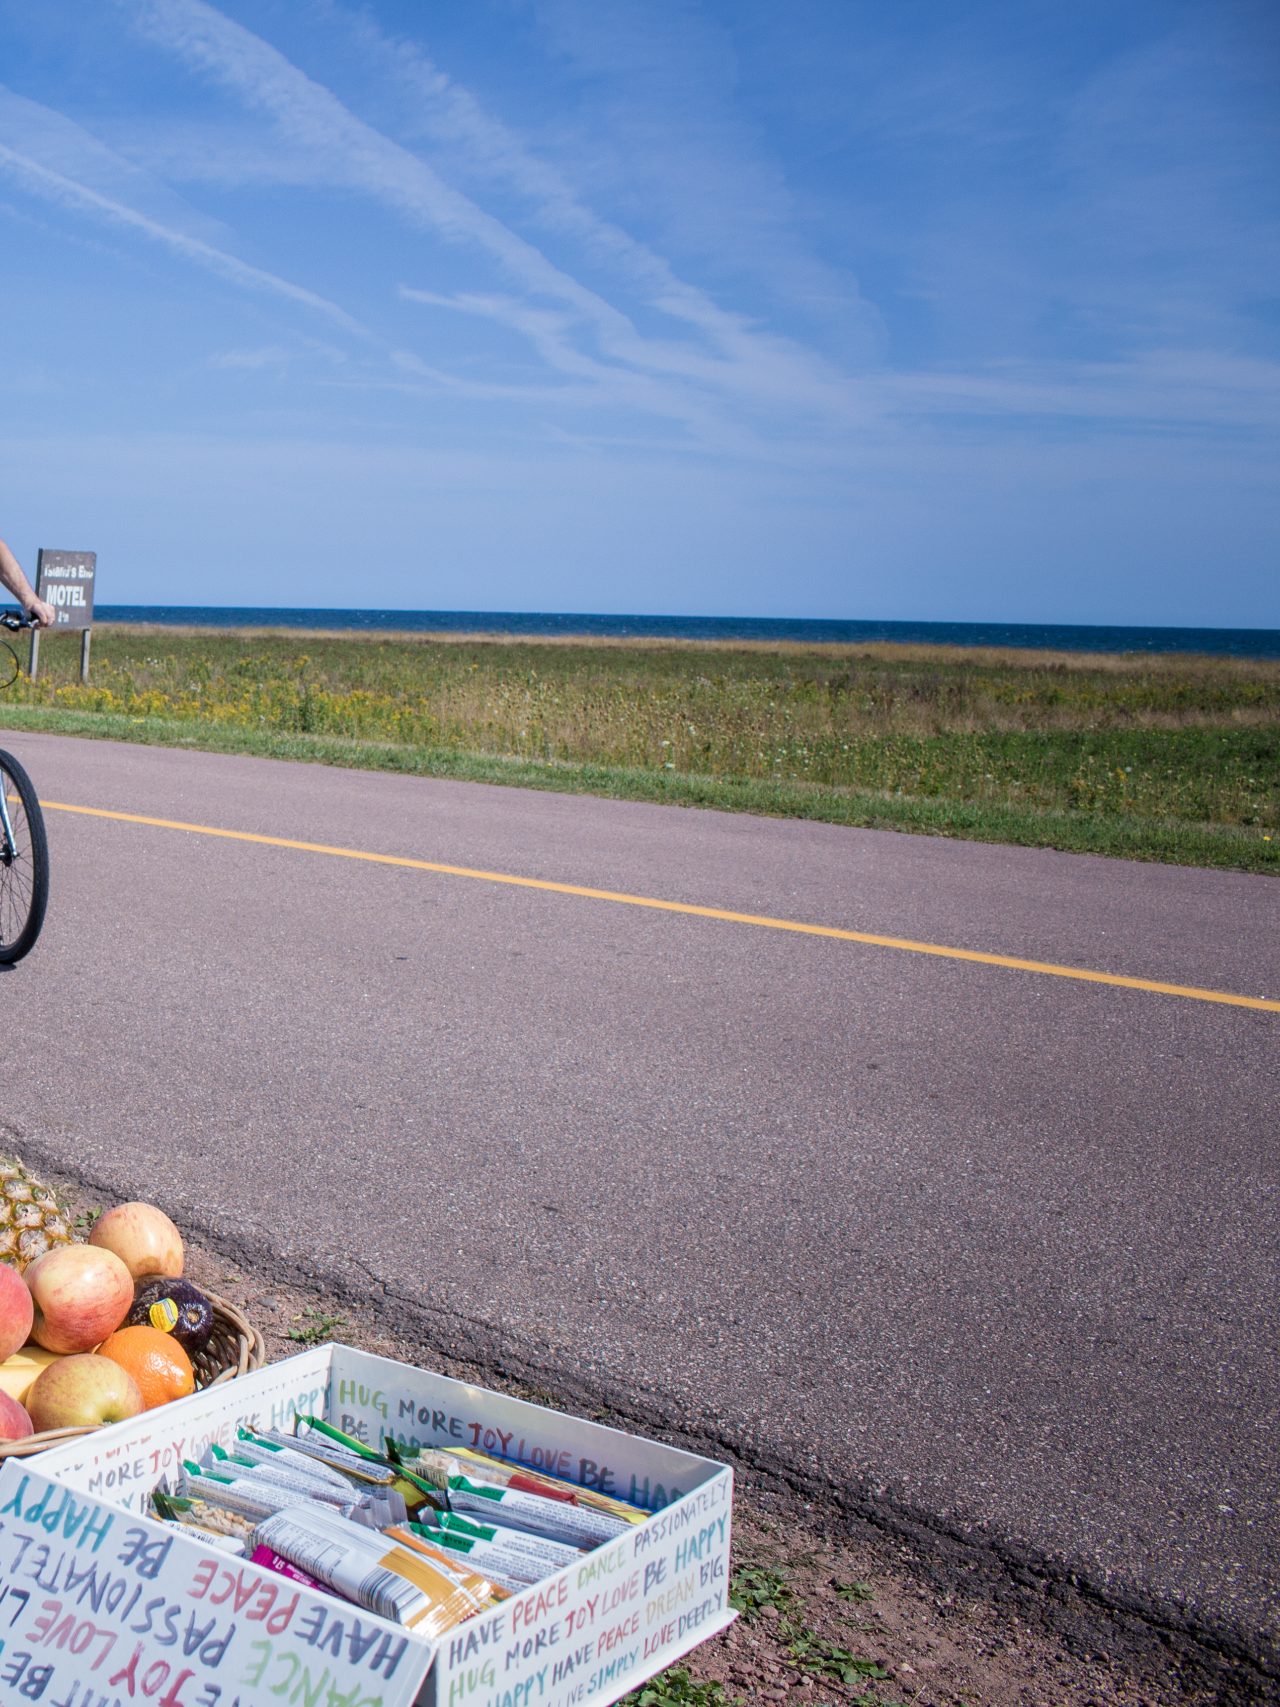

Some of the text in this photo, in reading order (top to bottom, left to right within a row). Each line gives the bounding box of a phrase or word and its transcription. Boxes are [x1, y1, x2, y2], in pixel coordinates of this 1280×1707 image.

[46, 585, 86, 607] MOTEL
[88, 1457, 145, 1496] MORE
[149, 1438, 186, 1474] JOY
[271, 1382, 331, 1428] HAPPY
[340, 1379, 388, 1420] HUG
[398, 1398, 464, 1439] MORE
[468, 1422, 514, 1457] JOY
[517, 1438, 572, 1477] LOVE
[579, 1458, 616, 1495] BE
[341, 1414, 370, 1443] BE
[0, 1475, 115, 1553] HAPPY
[118, 1527, 174, 1580] BE
[448, 1614, 505, 1670] HAVE
[512, 1575, 568, 1635] PEACE
[577, 1544, 625, 1590] DANCE
[633, 1474, 729, 1557] PASSIONATELY
[25, 1599, 118, 1670] LOVE
[186, 1558, 301, 1635] PEACE
[449, 1658, 496, 1707] HUG
[504, 1621, 561, 1671] MORE
[565, 1593, 599, 1639] JOY
[601, 1569, 640, 1616] LOVE
[643, 1556, 668, 1597] BE
[675, 1509, 727, 1574] HAPPY
[552, 1641, 594, 1686] HAVE
[598, 1609, 640, 1658] PEACE
[646, 1571, 695, 1626] DREAM
[700, 1553, 725, 1588] BIG
[1, 1651, 55, 1701] BE
[108, 1640, 196, 1707] JOY
[293, 1605, 409, 1680] HAVE
[586, 1645, 639, 1695] SIMPLY
[642, 1619, 677, 1660] LOVE
[678, 1588, 723, 1639] DEEPLY
